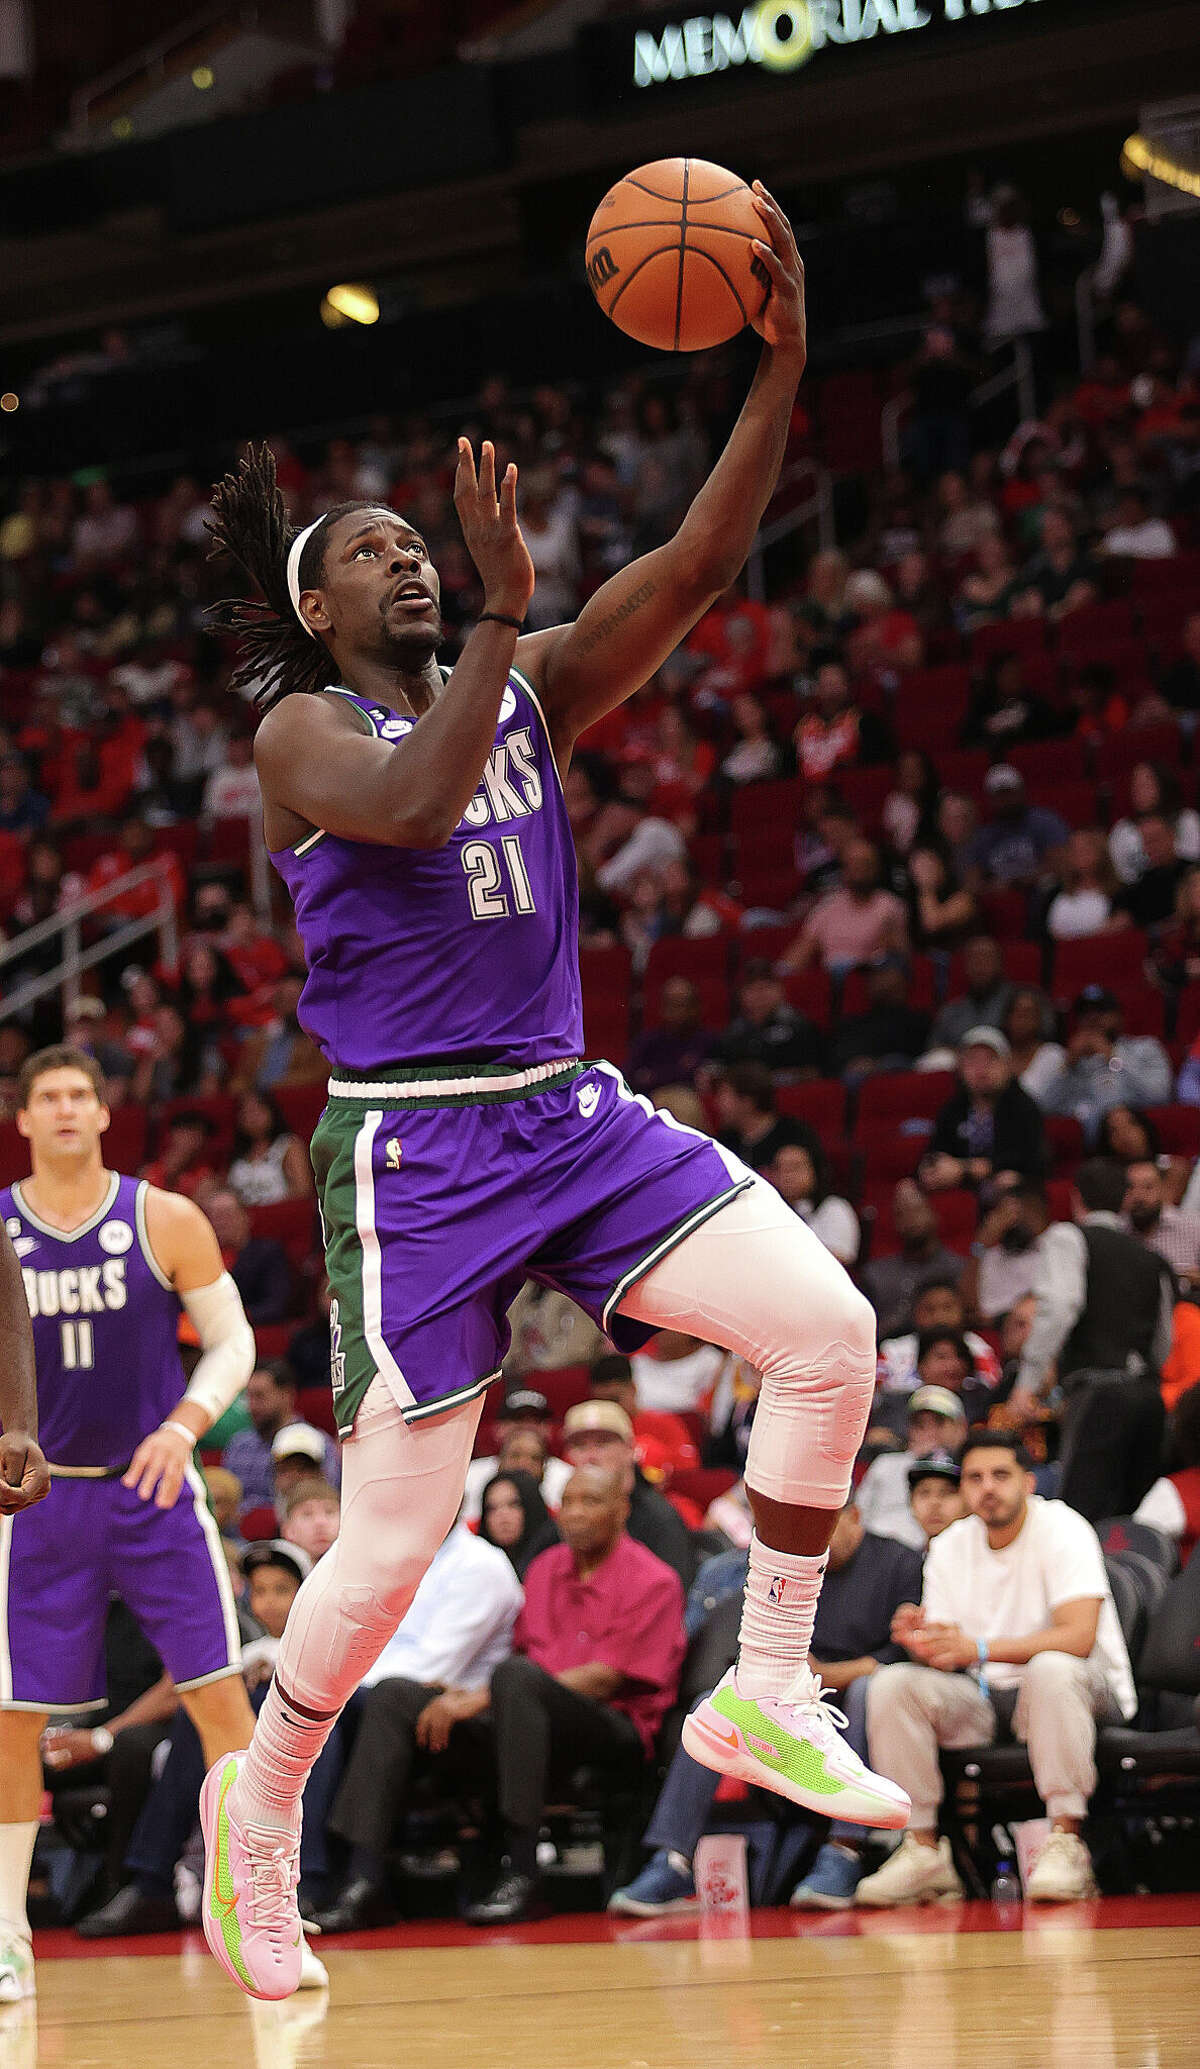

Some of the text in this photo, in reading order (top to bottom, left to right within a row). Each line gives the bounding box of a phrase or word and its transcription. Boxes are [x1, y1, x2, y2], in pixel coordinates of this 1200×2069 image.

[634, 0, 933, 88] MEMORIAL
[460, 835, 537, 920] 21
[60, 1319, 95, 1371] 11
